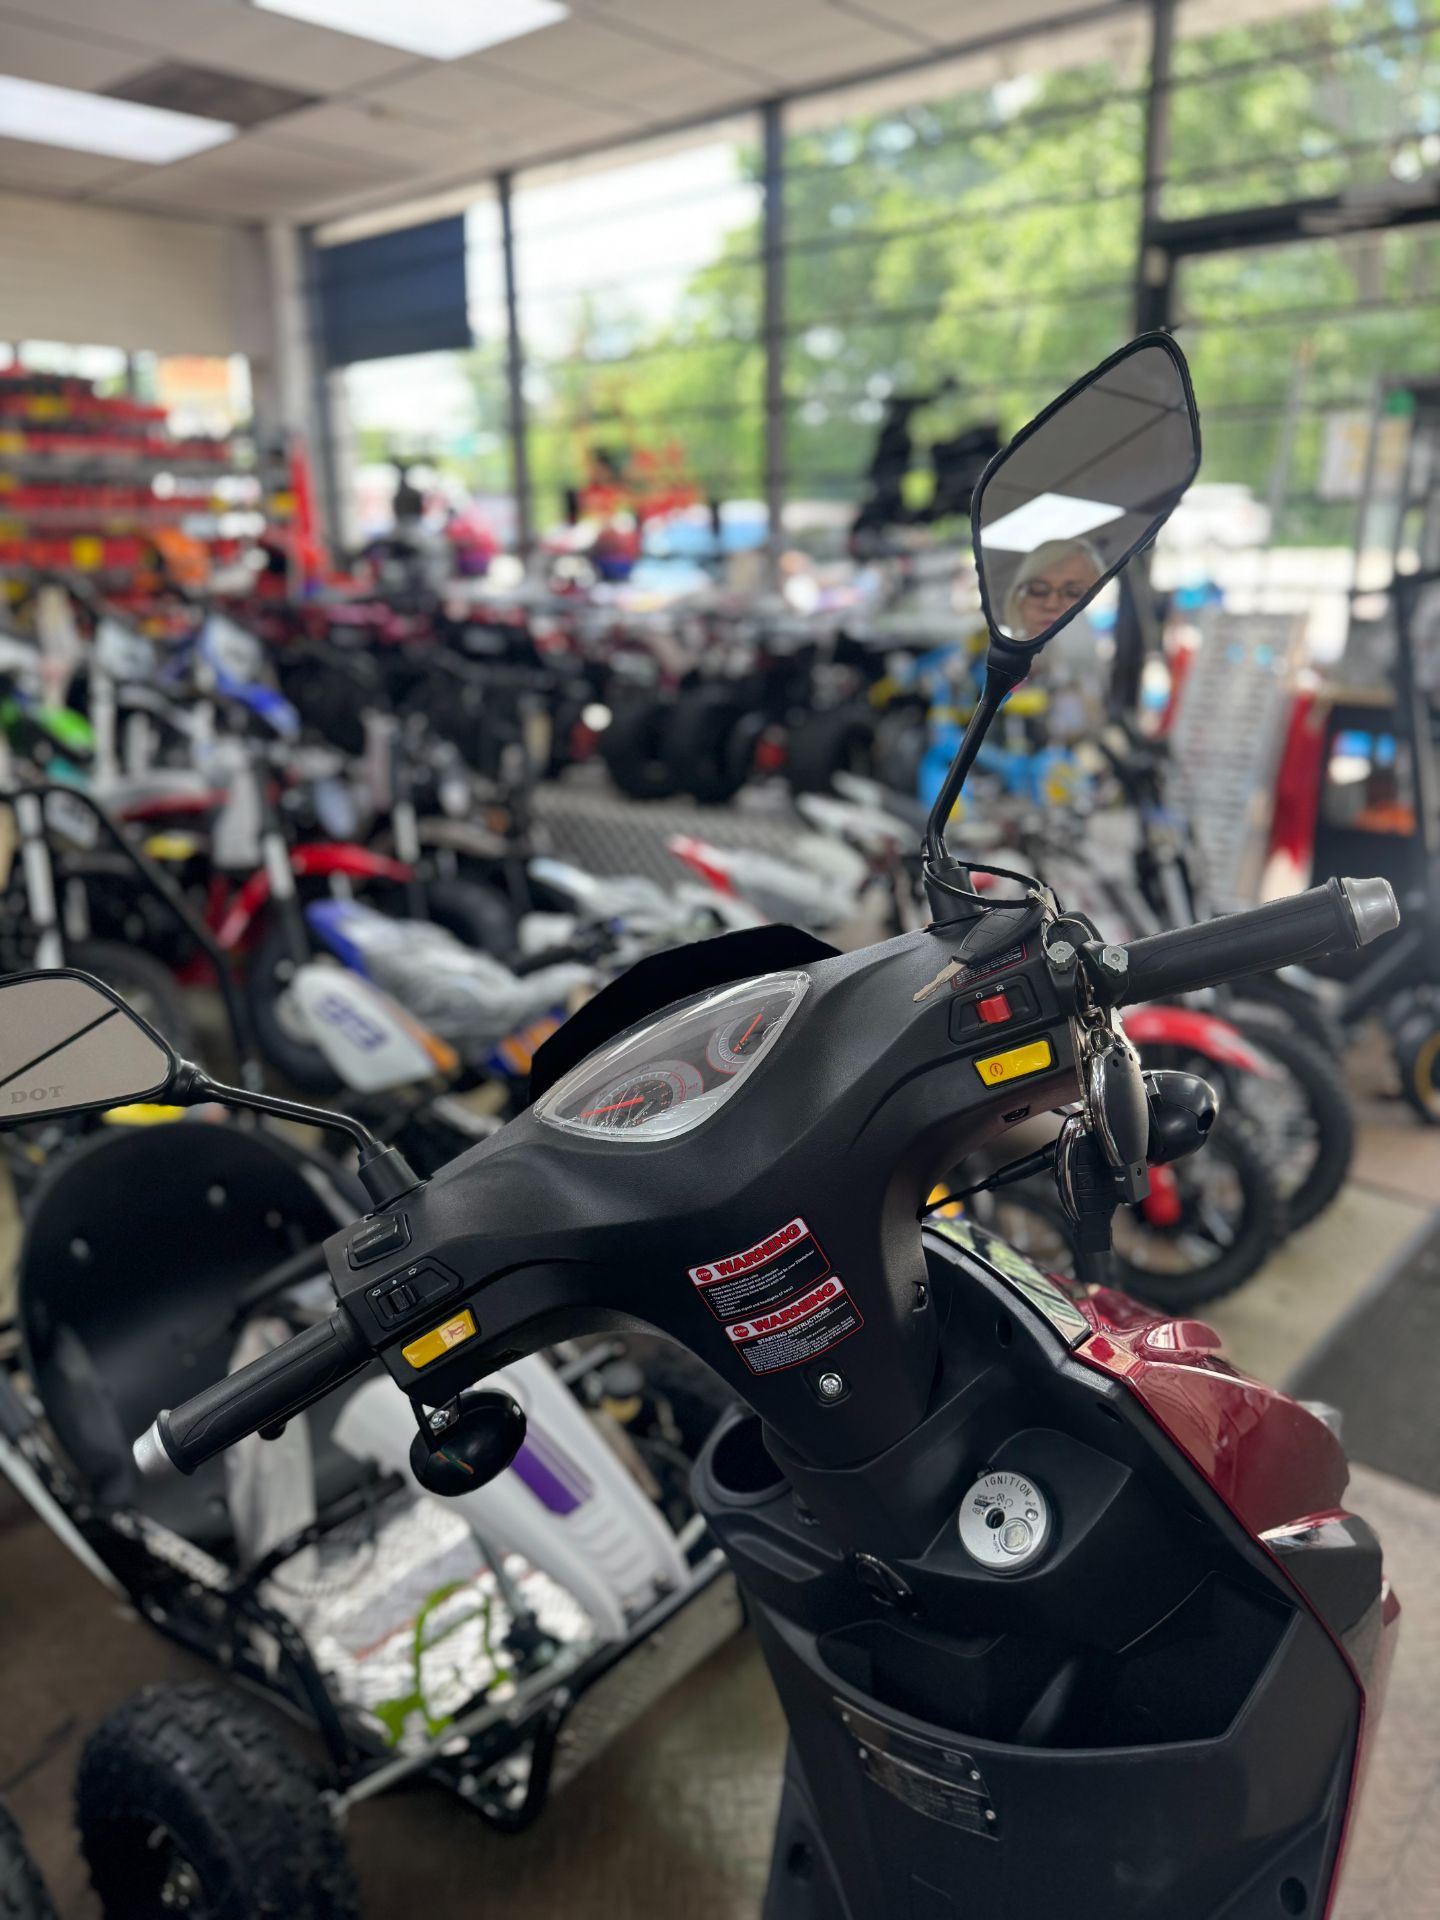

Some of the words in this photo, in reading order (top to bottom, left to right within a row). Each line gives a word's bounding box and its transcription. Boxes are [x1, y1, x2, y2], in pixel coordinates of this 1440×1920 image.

[11, 1085, 64, 1104] DOT
[697, 1271, 711, 1279] STOP
[713, 1224, 801, 1276] WARNING
[750, 1282, 836, 1332] WARNING
[758, 1331, 788, 1345] STARTING
[788, 1307, 831, 1336] INSTRUCTIONS
[985, 1475, 1032, 1497] IGNITION
